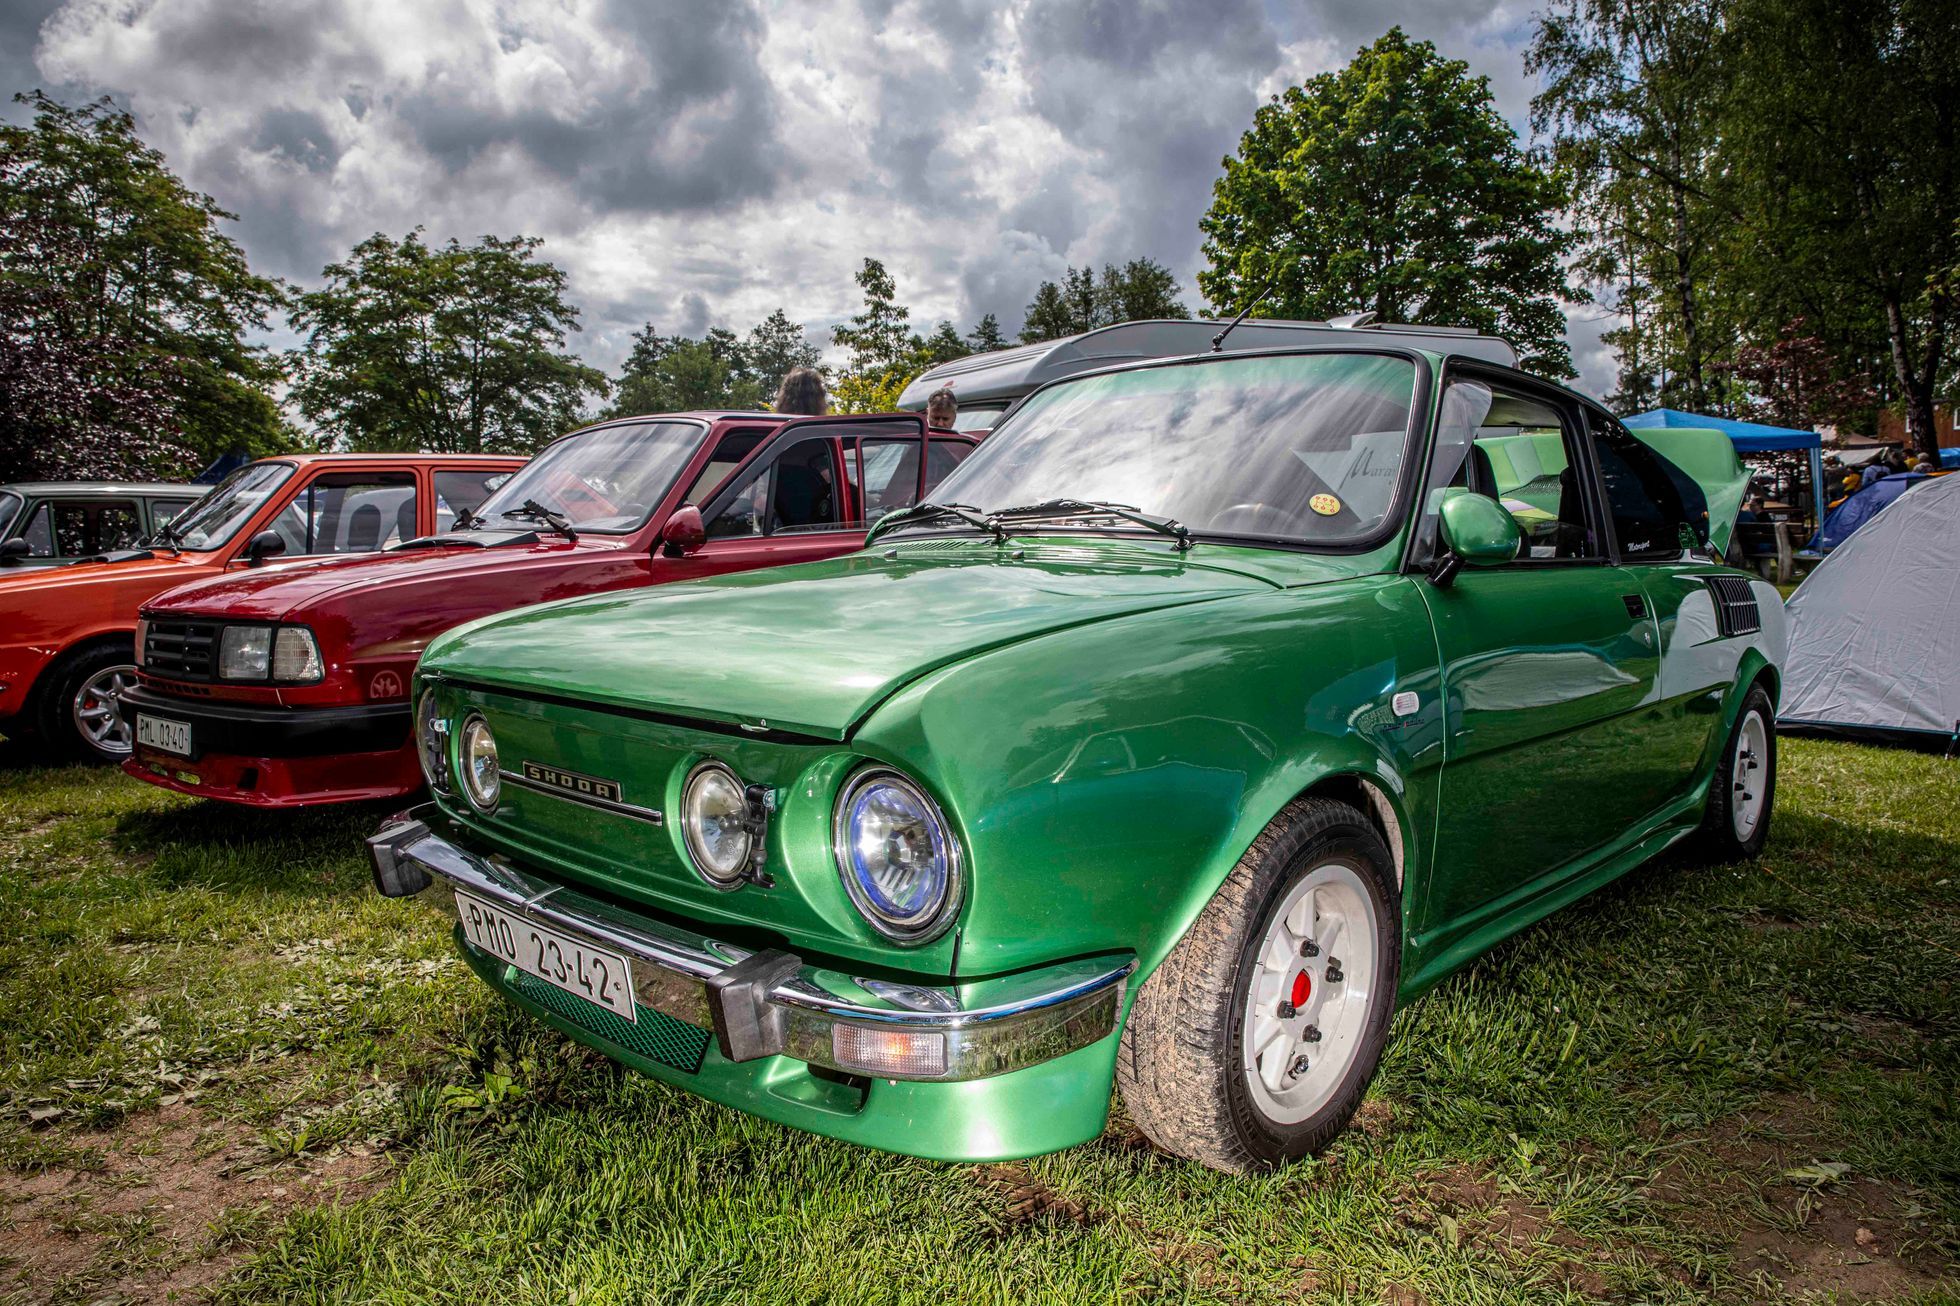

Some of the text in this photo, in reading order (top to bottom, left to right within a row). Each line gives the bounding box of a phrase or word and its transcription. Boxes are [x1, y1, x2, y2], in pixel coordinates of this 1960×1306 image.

[140, 718, 155, 743] PML
[469, 903, 616, 1007] PMO 23-42
